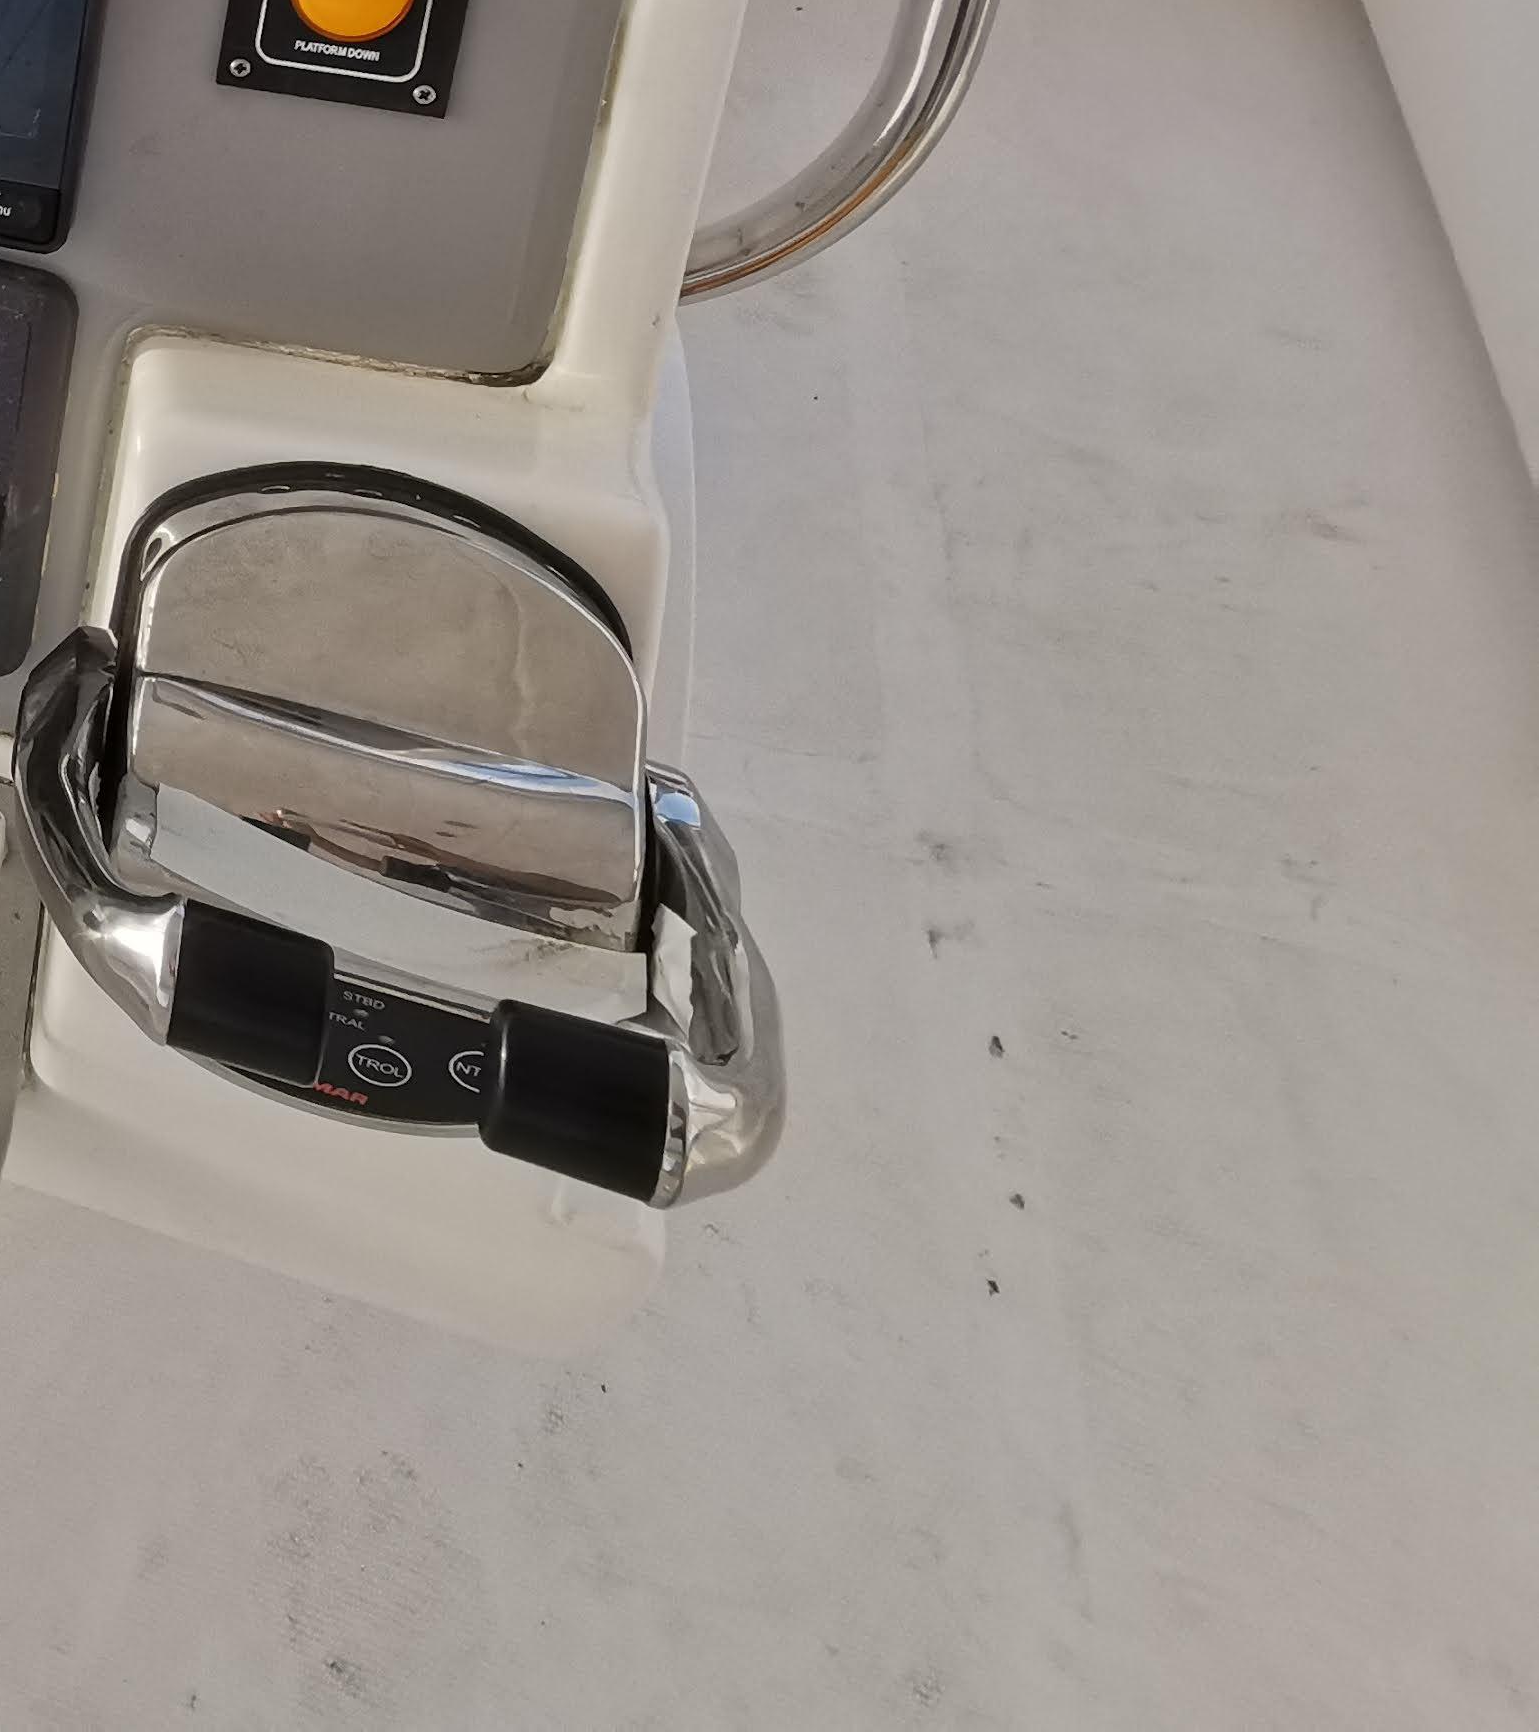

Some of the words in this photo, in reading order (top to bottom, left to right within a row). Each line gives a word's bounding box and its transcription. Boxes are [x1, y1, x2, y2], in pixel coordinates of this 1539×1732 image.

[294, 39, 347, 58] PLATFORM
[347, 47, 380, 62] DOWN
[343, 990, 386, 1011] STBD
[328, 1011, 366, 1032] TRAL
[313, 1083, 368, 1105] MAR
